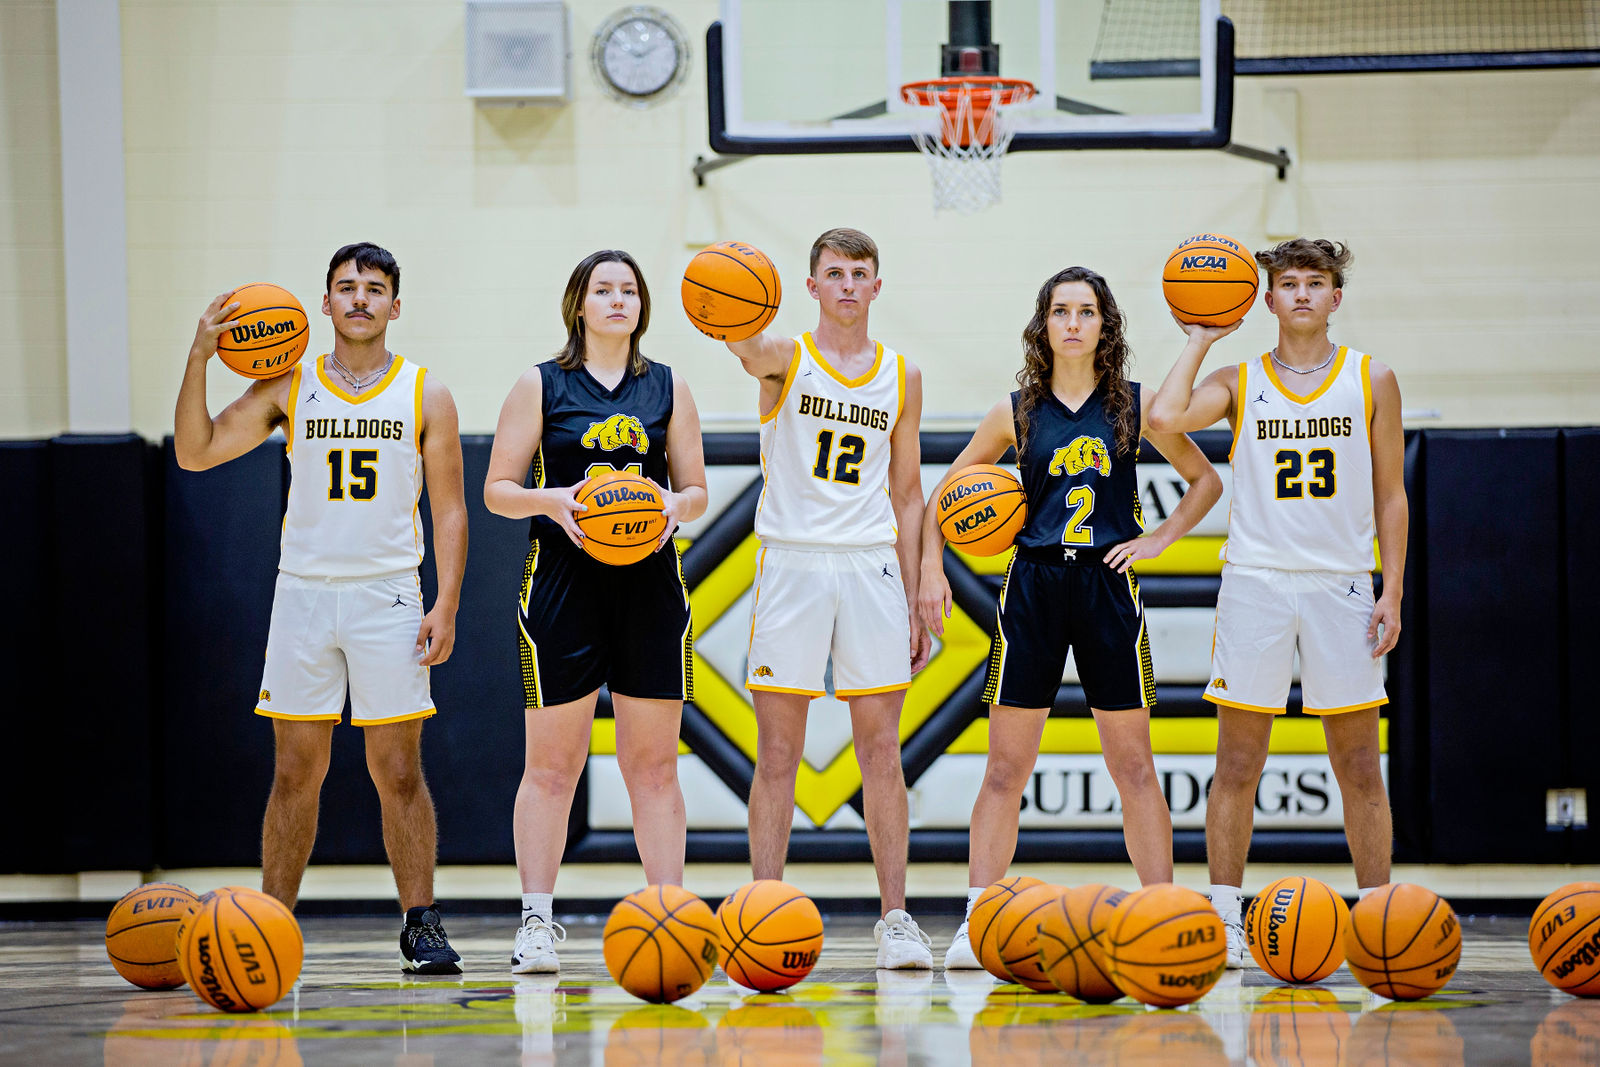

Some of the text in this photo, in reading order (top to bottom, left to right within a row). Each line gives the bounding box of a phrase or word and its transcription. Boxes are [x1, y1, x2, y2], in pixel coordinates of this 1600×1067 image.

[1180, 255, 1227, 270] NCAA
[230, 320, 296, 344] Wilson
[252, 351, 289, 369] EVO
[799, 394, 889, 431] BULLDOGS
[305, 418, 403, 441] BULLDOGS
[1256, 417, 1352, 440] BULLDOGS
[812, 428, 867, 486] 12
[326, 448, 379, 501] 15
[1274, 446, 1337, 500] 23
[594, 487, 656, 507] Wilson
[940, 481, 995, 512] Wilson
[611, 521, 648, 535] EVO
[954, 505, 997, 535] NCAA
[1061, 484, 1096, 547] 2
[1018, 769, 1330, 815] ULDGS
[133, 897, 175, 914] EVO
[1176, 926, 1216, 949] EVO
[1268, 888, 1296, 957] Wilson
[1541, 905, 1576, 942] EVO
[236, 943, 266, 985] EVO
